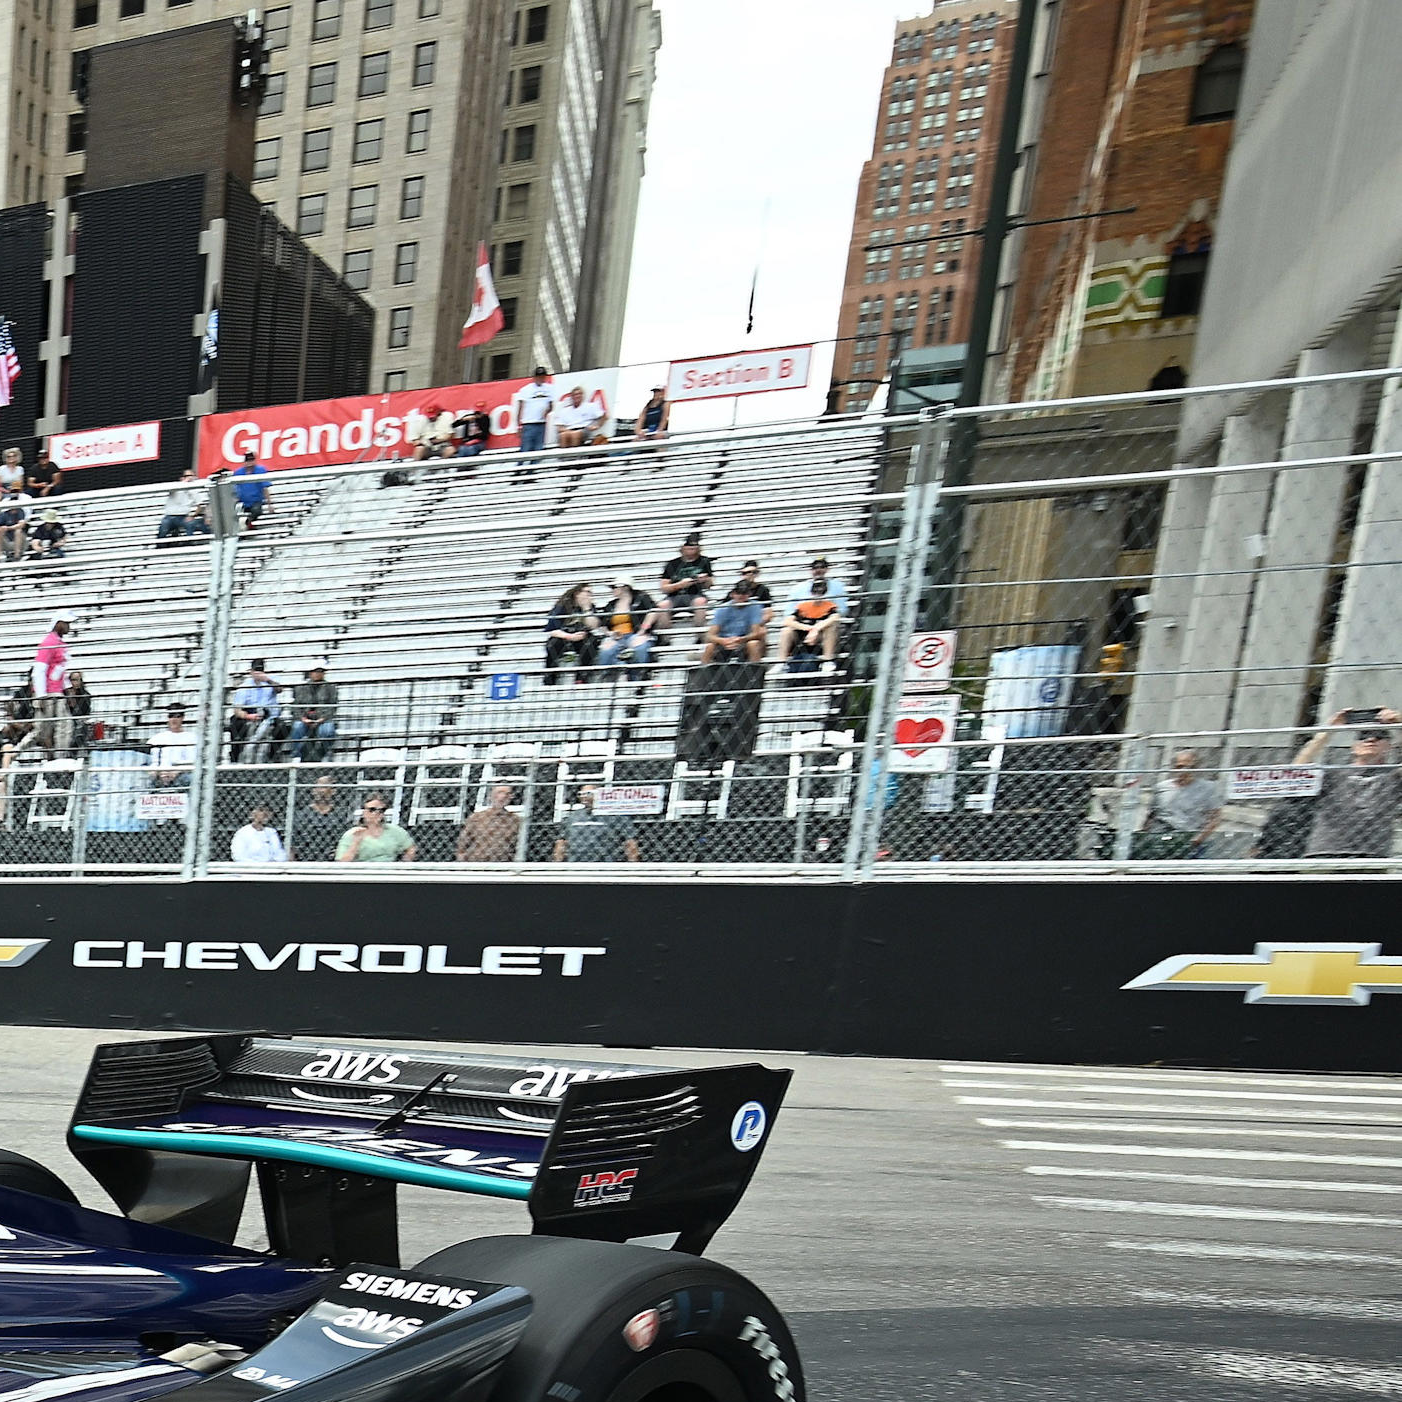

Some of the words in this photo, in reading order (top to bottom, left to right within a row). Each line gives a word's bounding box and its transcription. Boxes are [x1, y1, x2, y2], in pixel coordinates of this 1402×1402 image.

[682, 364, 770, 390] Section
[777, 358, 795, 379] B
[221, 393, 519, 463] Grandstd
[62, 438, 126, 460] Section
[72, 940, 607, 977] CHEVROLET
[300, 1048, 410, 1085] aws
[509, 1064, 636, 1098] aw
[575, 1168, 639, 1201] HRC
[340, 1272, 479, 1309] SIEMENS
[334, 1307, 424, 1338] aws
